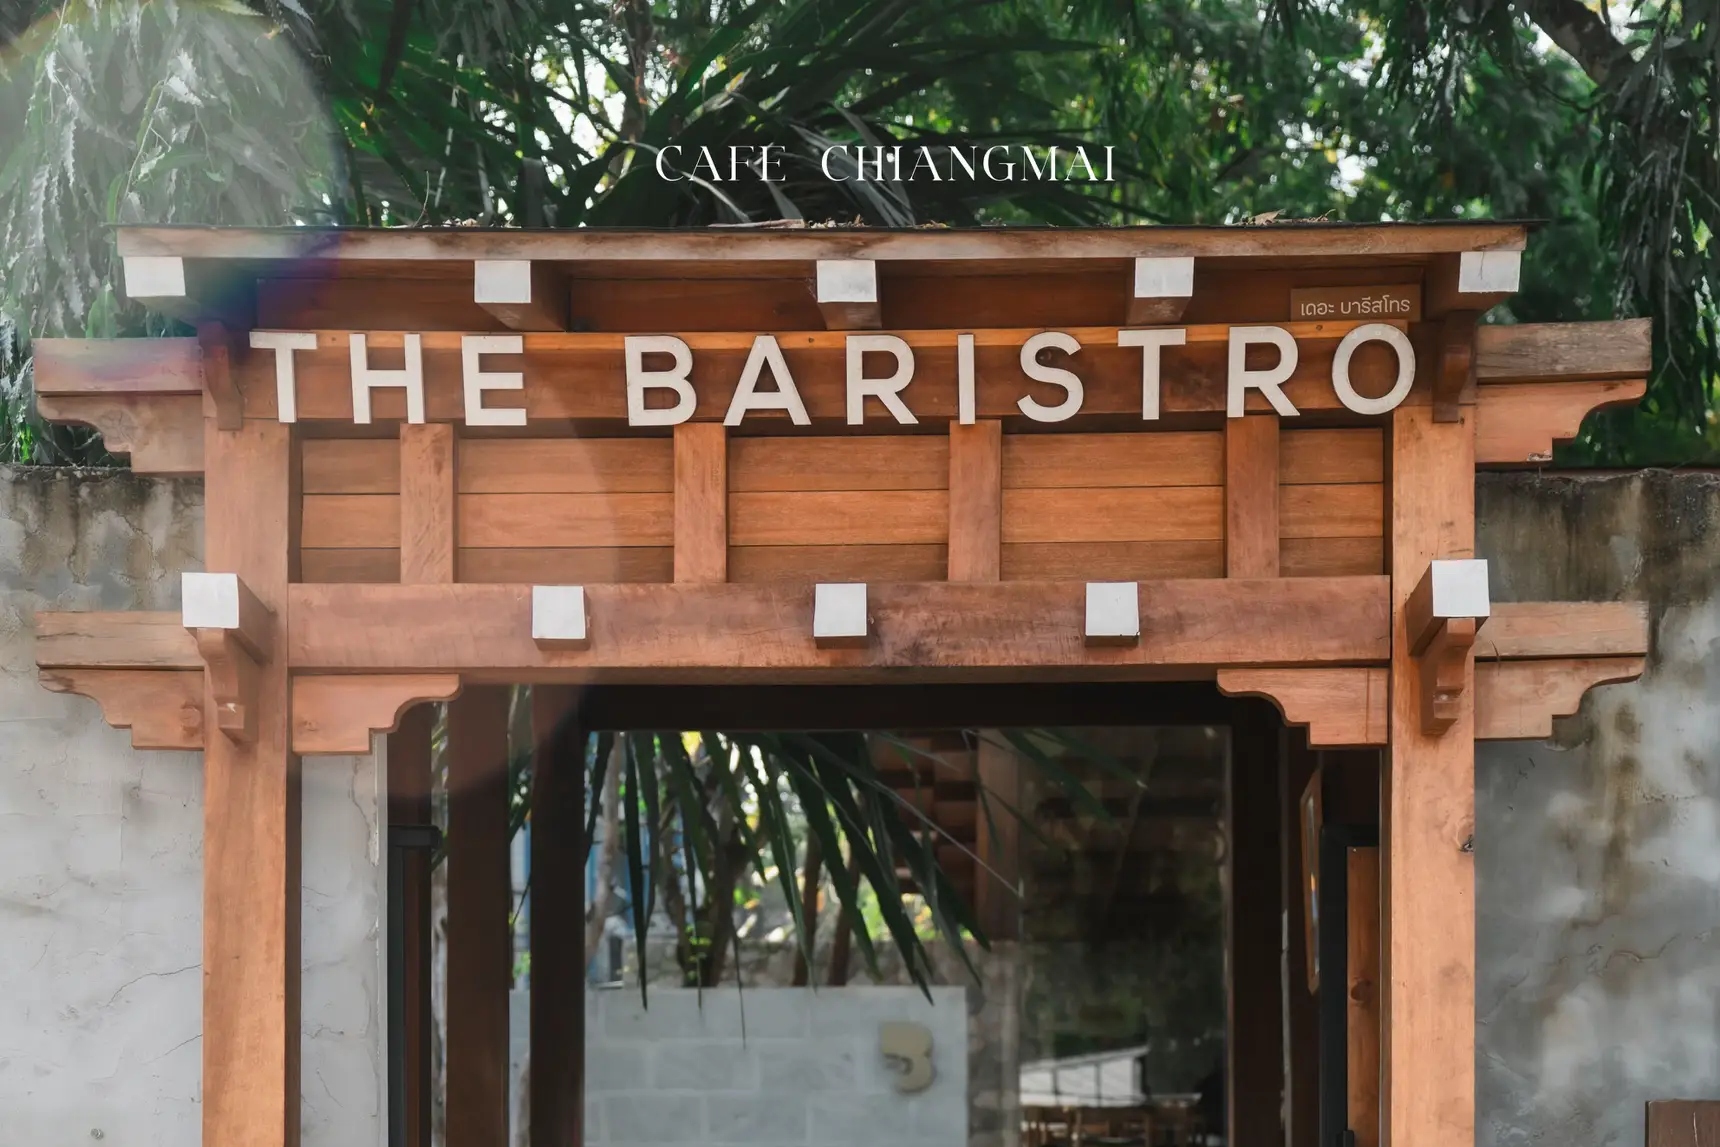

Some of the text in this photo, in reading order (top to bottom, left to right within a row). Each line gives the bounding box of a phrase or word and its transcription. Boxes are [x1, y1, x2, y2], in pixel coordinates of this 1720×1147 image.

[1300, 294, 1411, 316] เดอะ บารีสโทร
[249, 323, 1416, 427] THE BARISTRO
